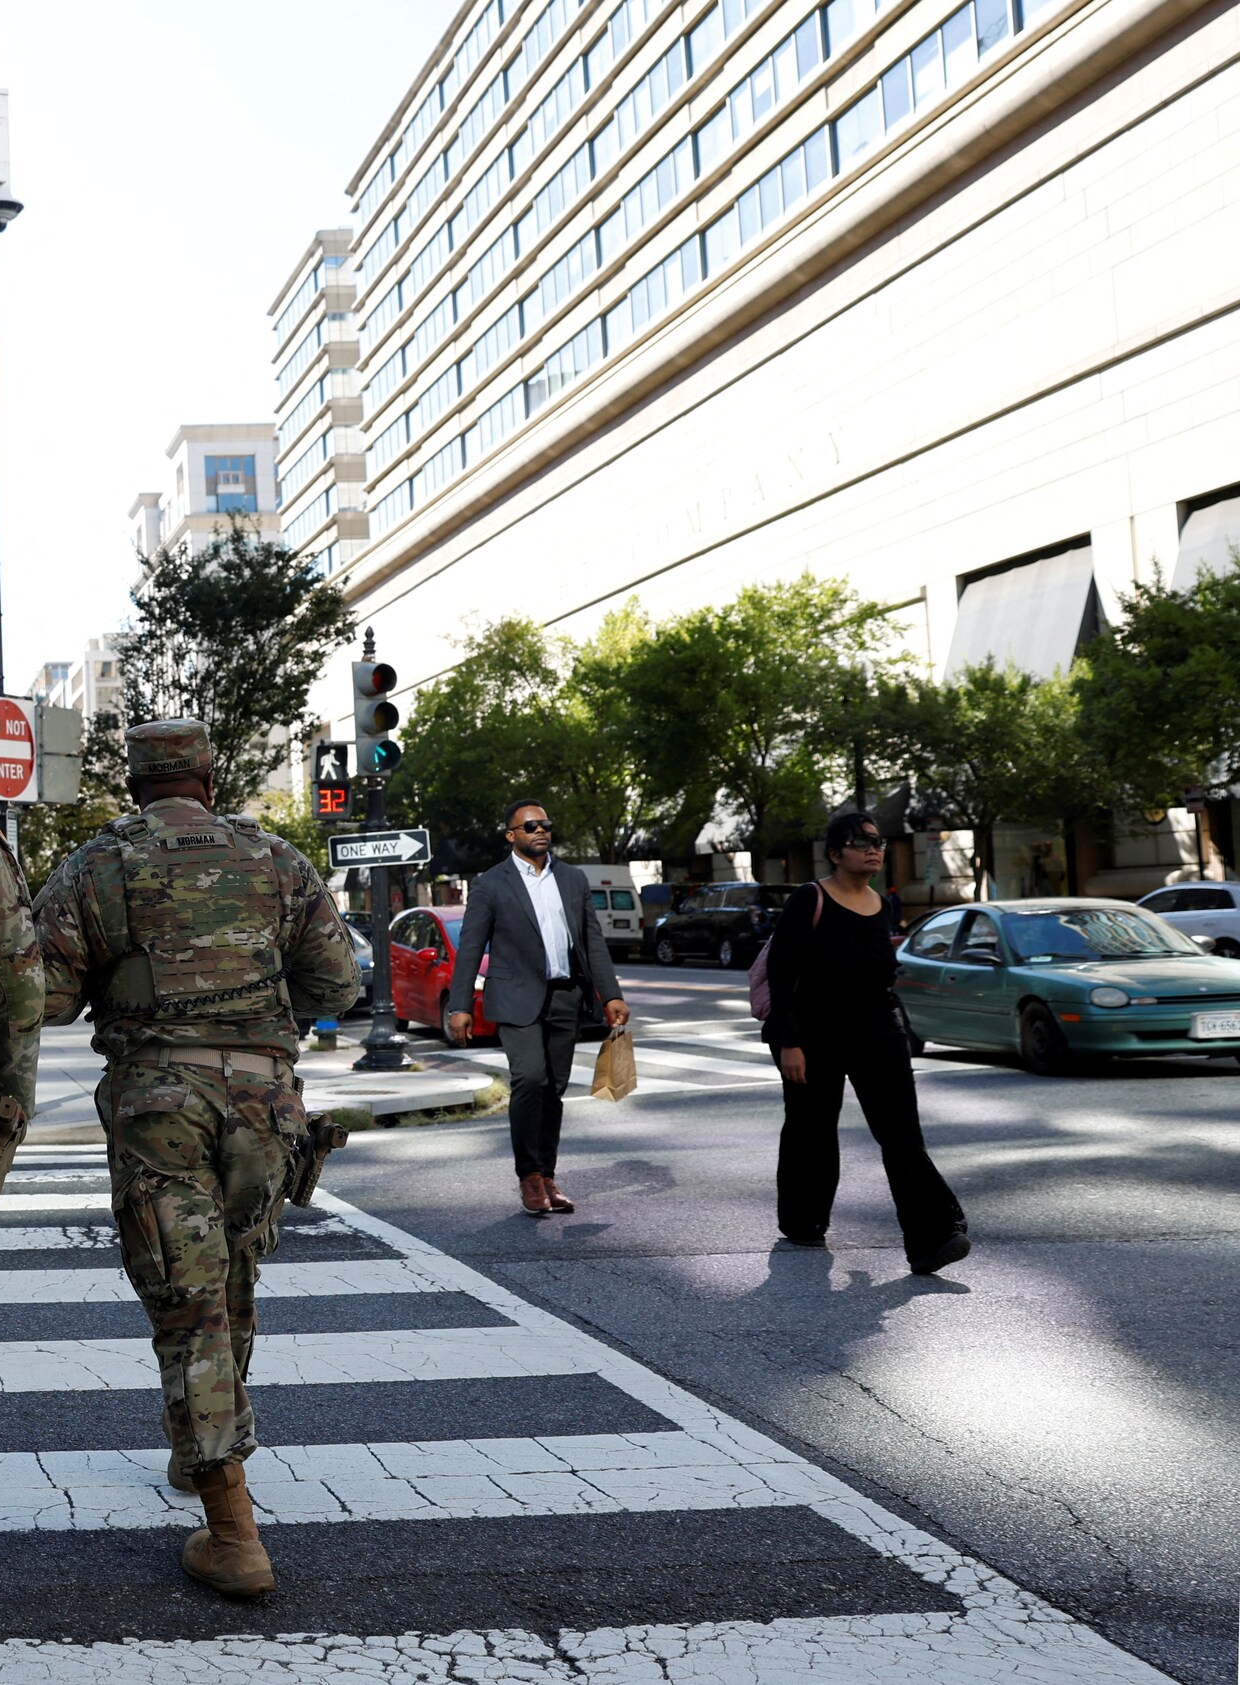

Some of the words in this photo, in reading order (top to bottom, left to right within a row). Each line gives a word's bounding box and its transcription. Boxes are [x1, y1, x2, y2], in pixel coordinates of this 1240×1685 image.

[6, 719, 26, 736] NOT
[148, 759, 190, 773] MORMAN
[318, 789, 345, 813] 32
[176, 834, 215, 846] MORMAN
[341, 843, 366, 857] ONE
[371, 842, 398, 855] WAY
